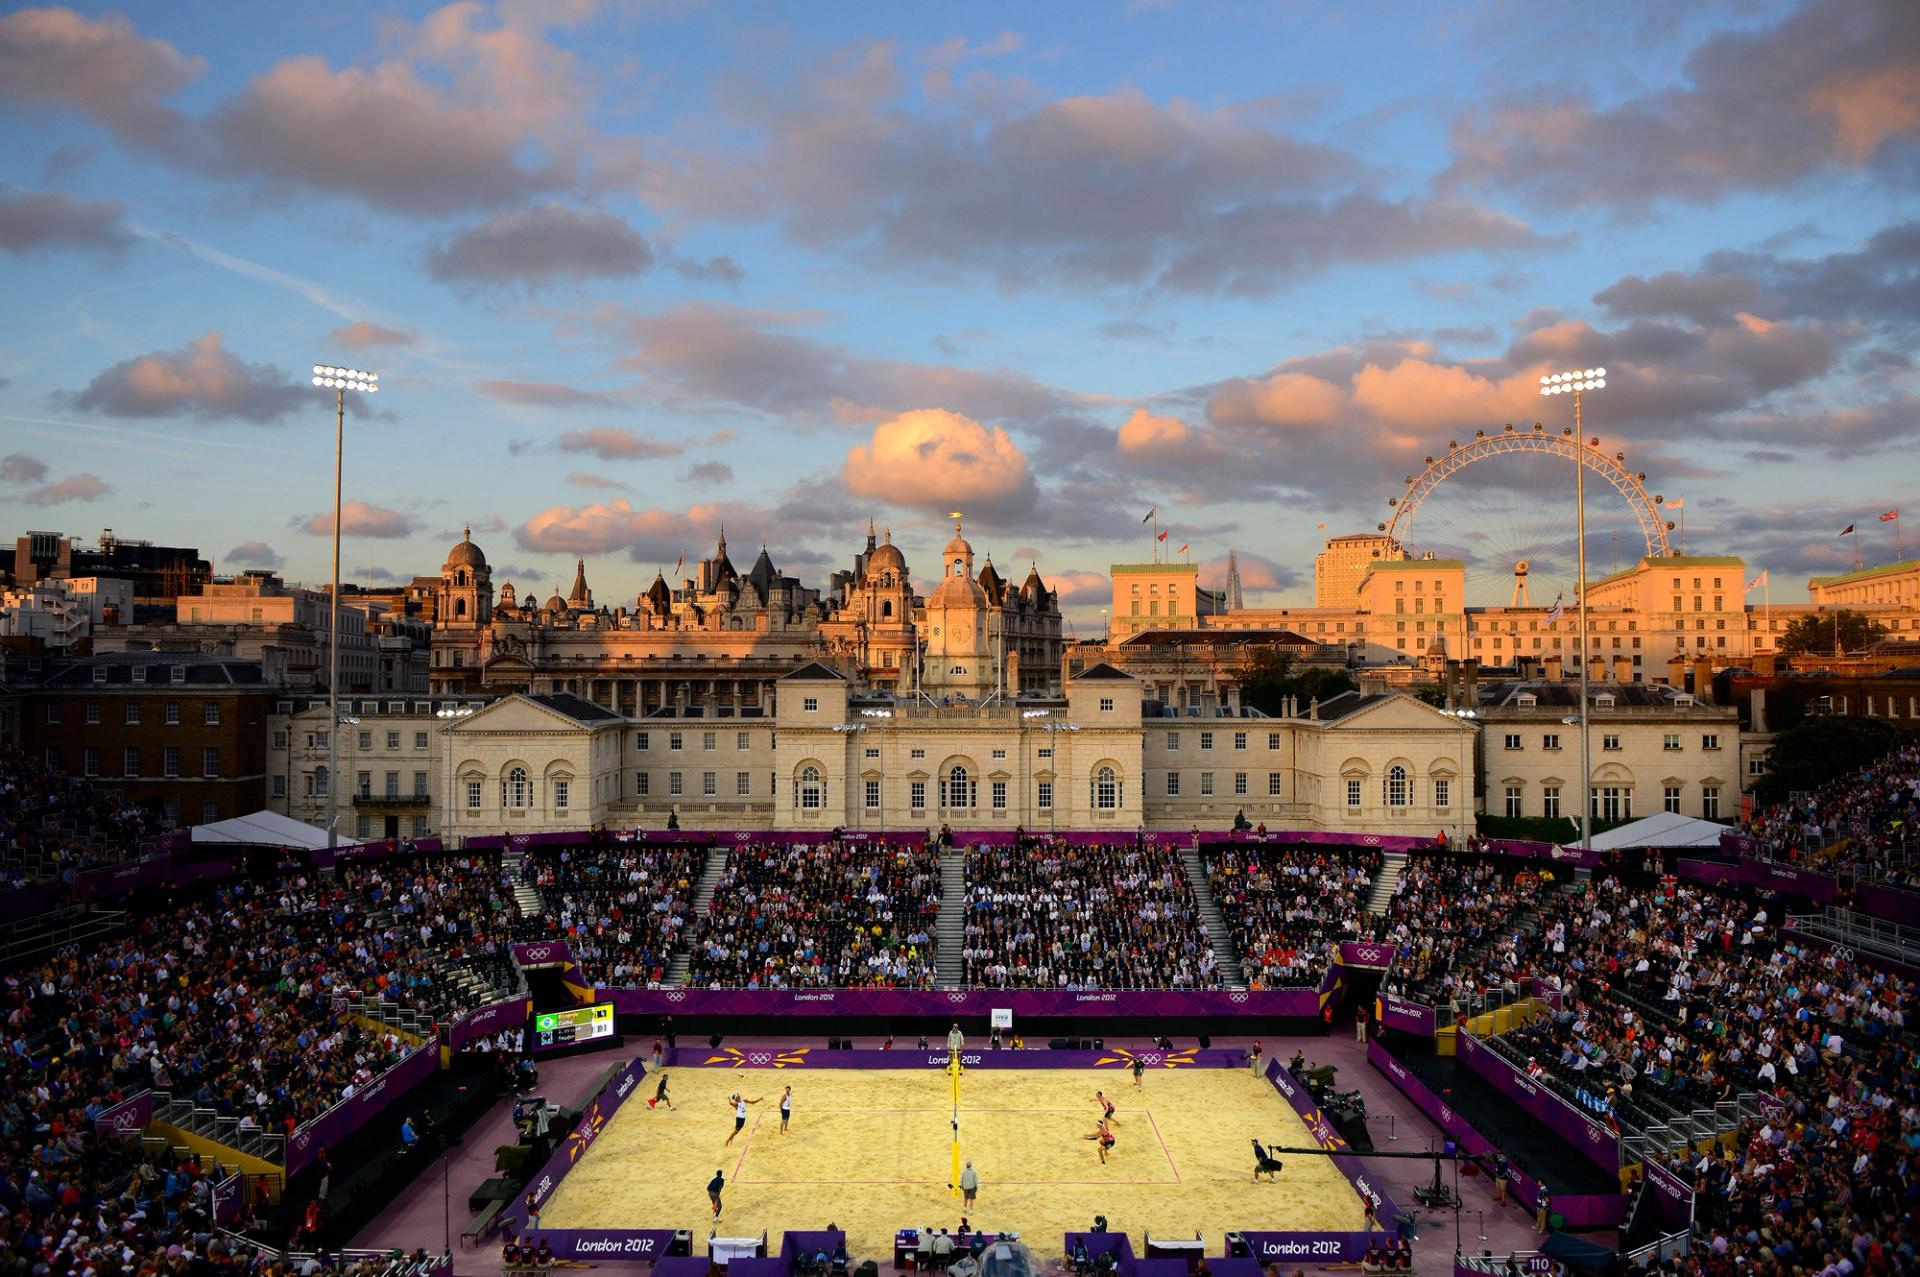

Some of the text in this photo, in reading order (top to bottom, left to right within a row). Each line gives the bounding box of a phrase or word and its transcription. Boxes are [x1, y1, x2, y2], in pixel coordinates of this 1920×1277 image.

[794, 993, 834, 1001] London 2012
[1388, 1003, 1422, 1018] London 2012
[928, 1055, 981, 1065] Lond 2012
[1648, 1169, 1681, 1200] London 2012
[576, 1238, 655, 1252] London 2012
[1263, 1240, 1341, 1255] London 2012
[1530, 1258, 1549, 1270] 110
